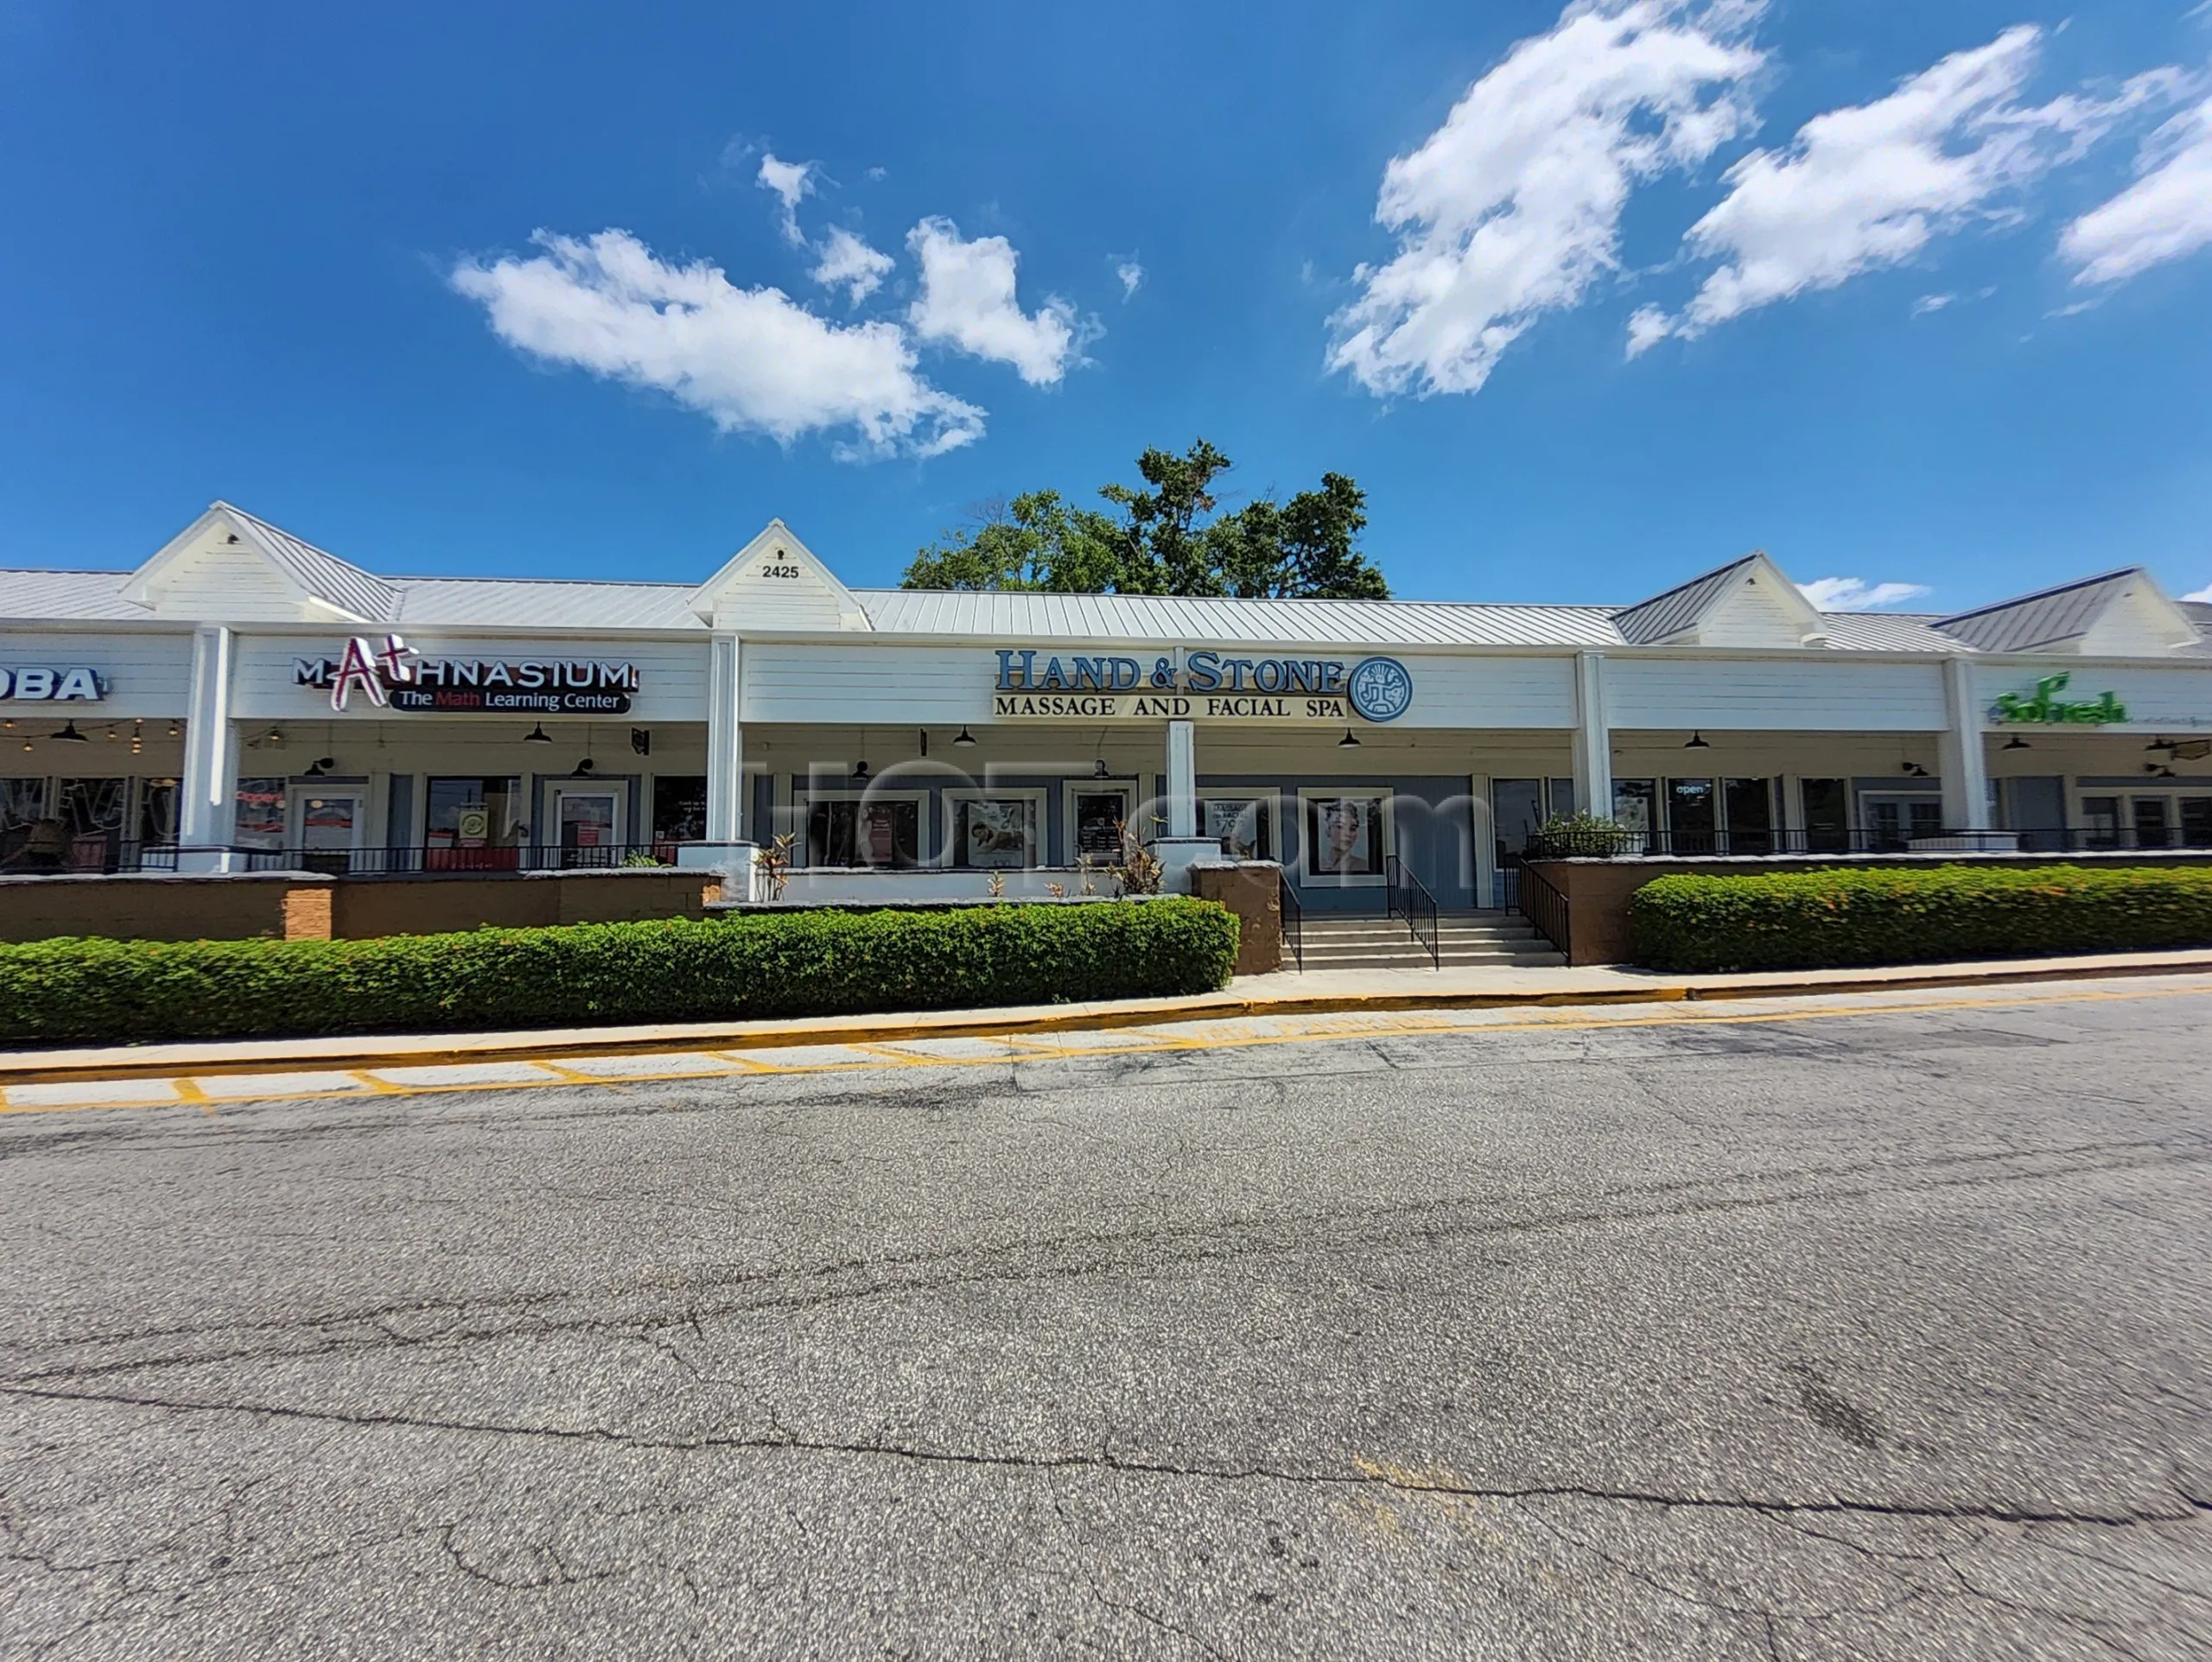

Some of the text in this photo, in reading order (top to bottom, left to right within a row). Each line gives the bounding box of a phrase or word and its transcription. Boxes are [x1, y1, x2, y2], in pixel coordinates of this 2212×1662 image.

[762, 565, 799, 579] 2425
[995, 650, 1346, 693] HAND & STONE
[0, 667, 104, 701] BA
[400, 691, 620, 711] The Math Learning Center
[995, 697, 1344, 718] MASSAGE AND FACIAL SPA
[1676, 786, 1703, 796] open
